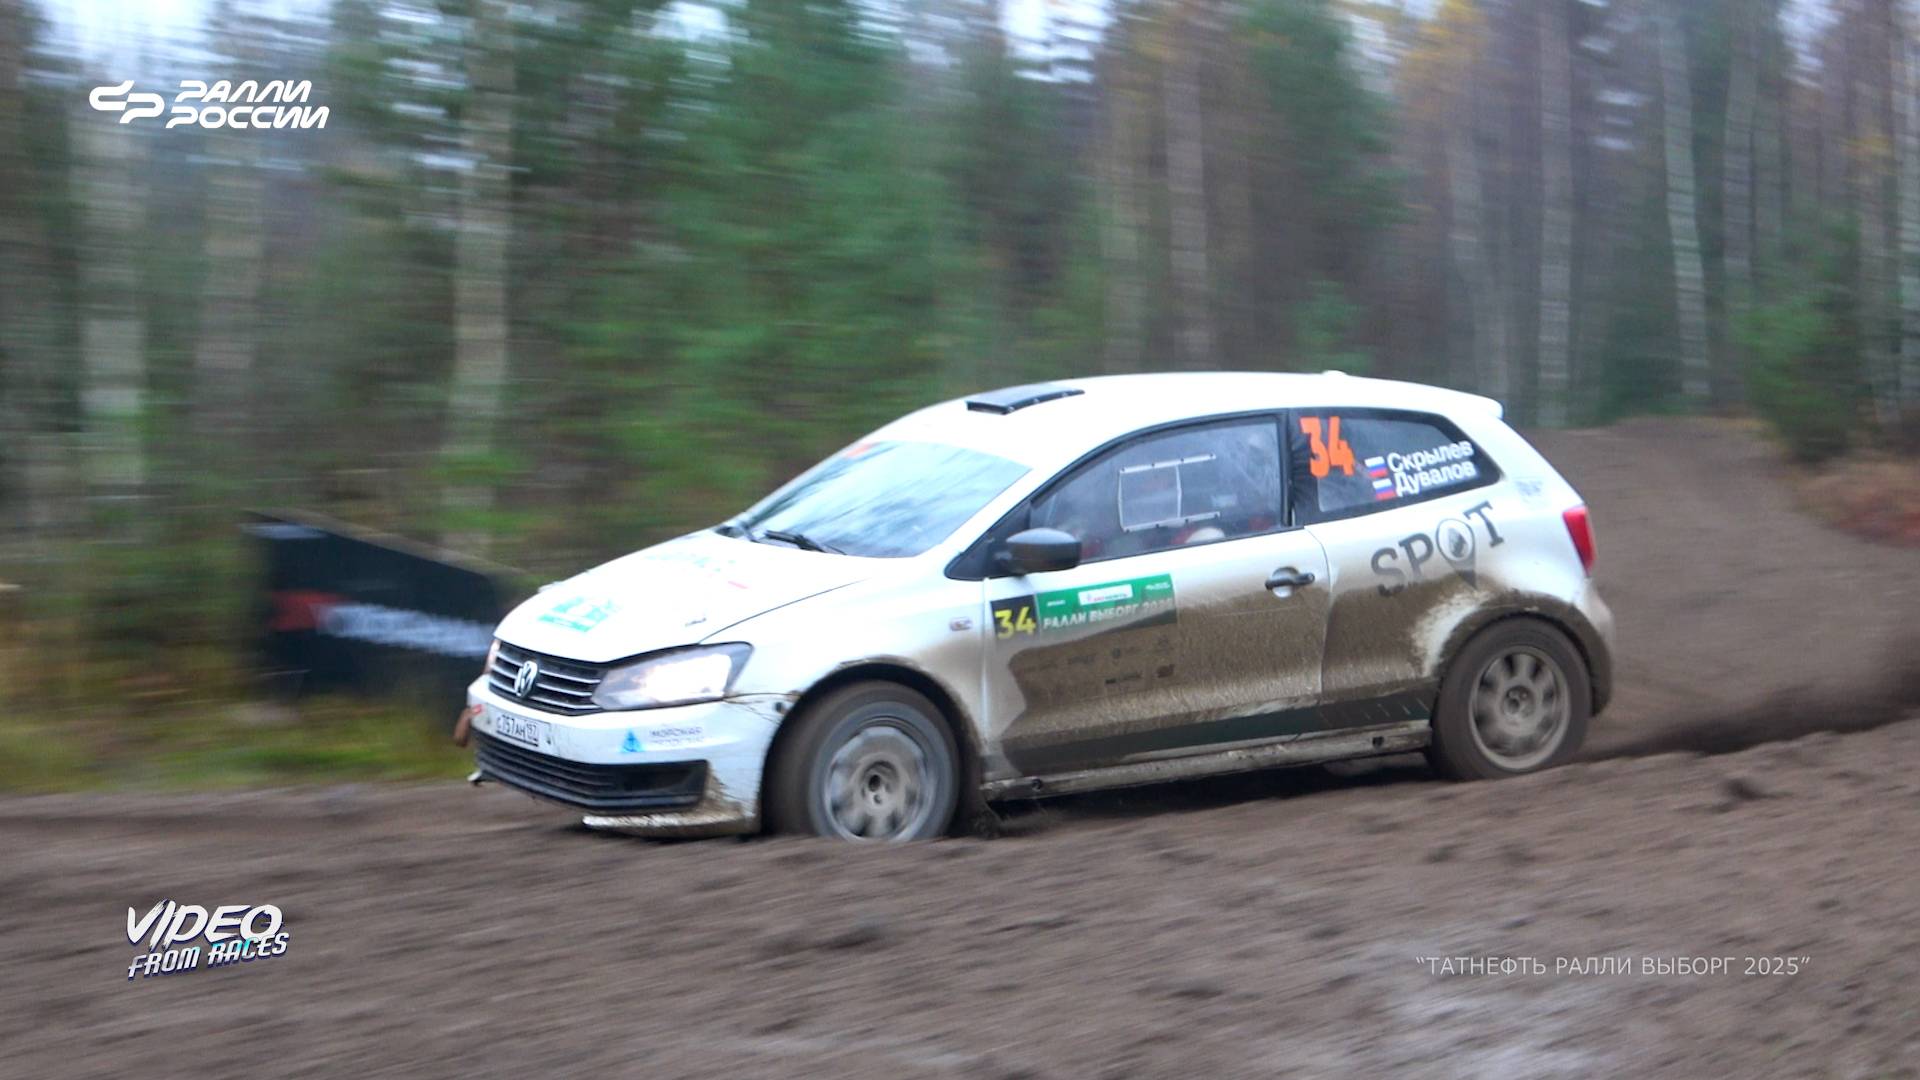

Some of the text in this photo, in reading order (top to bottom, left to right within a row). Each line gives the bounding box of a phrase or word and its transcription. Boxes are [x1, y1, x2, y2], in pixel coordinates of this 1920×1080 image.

[1299, 415, 1356, 479] 34
[1394, 461, 1478, 497] Дувалов
[1370, 500, 1504, 598] SPOT
[995, 606, 1036, 639] 34
[1043, 612, 1087, 630] РАЛЛИ
[1089, 603, 1139, 623] ВЫБОРГ
